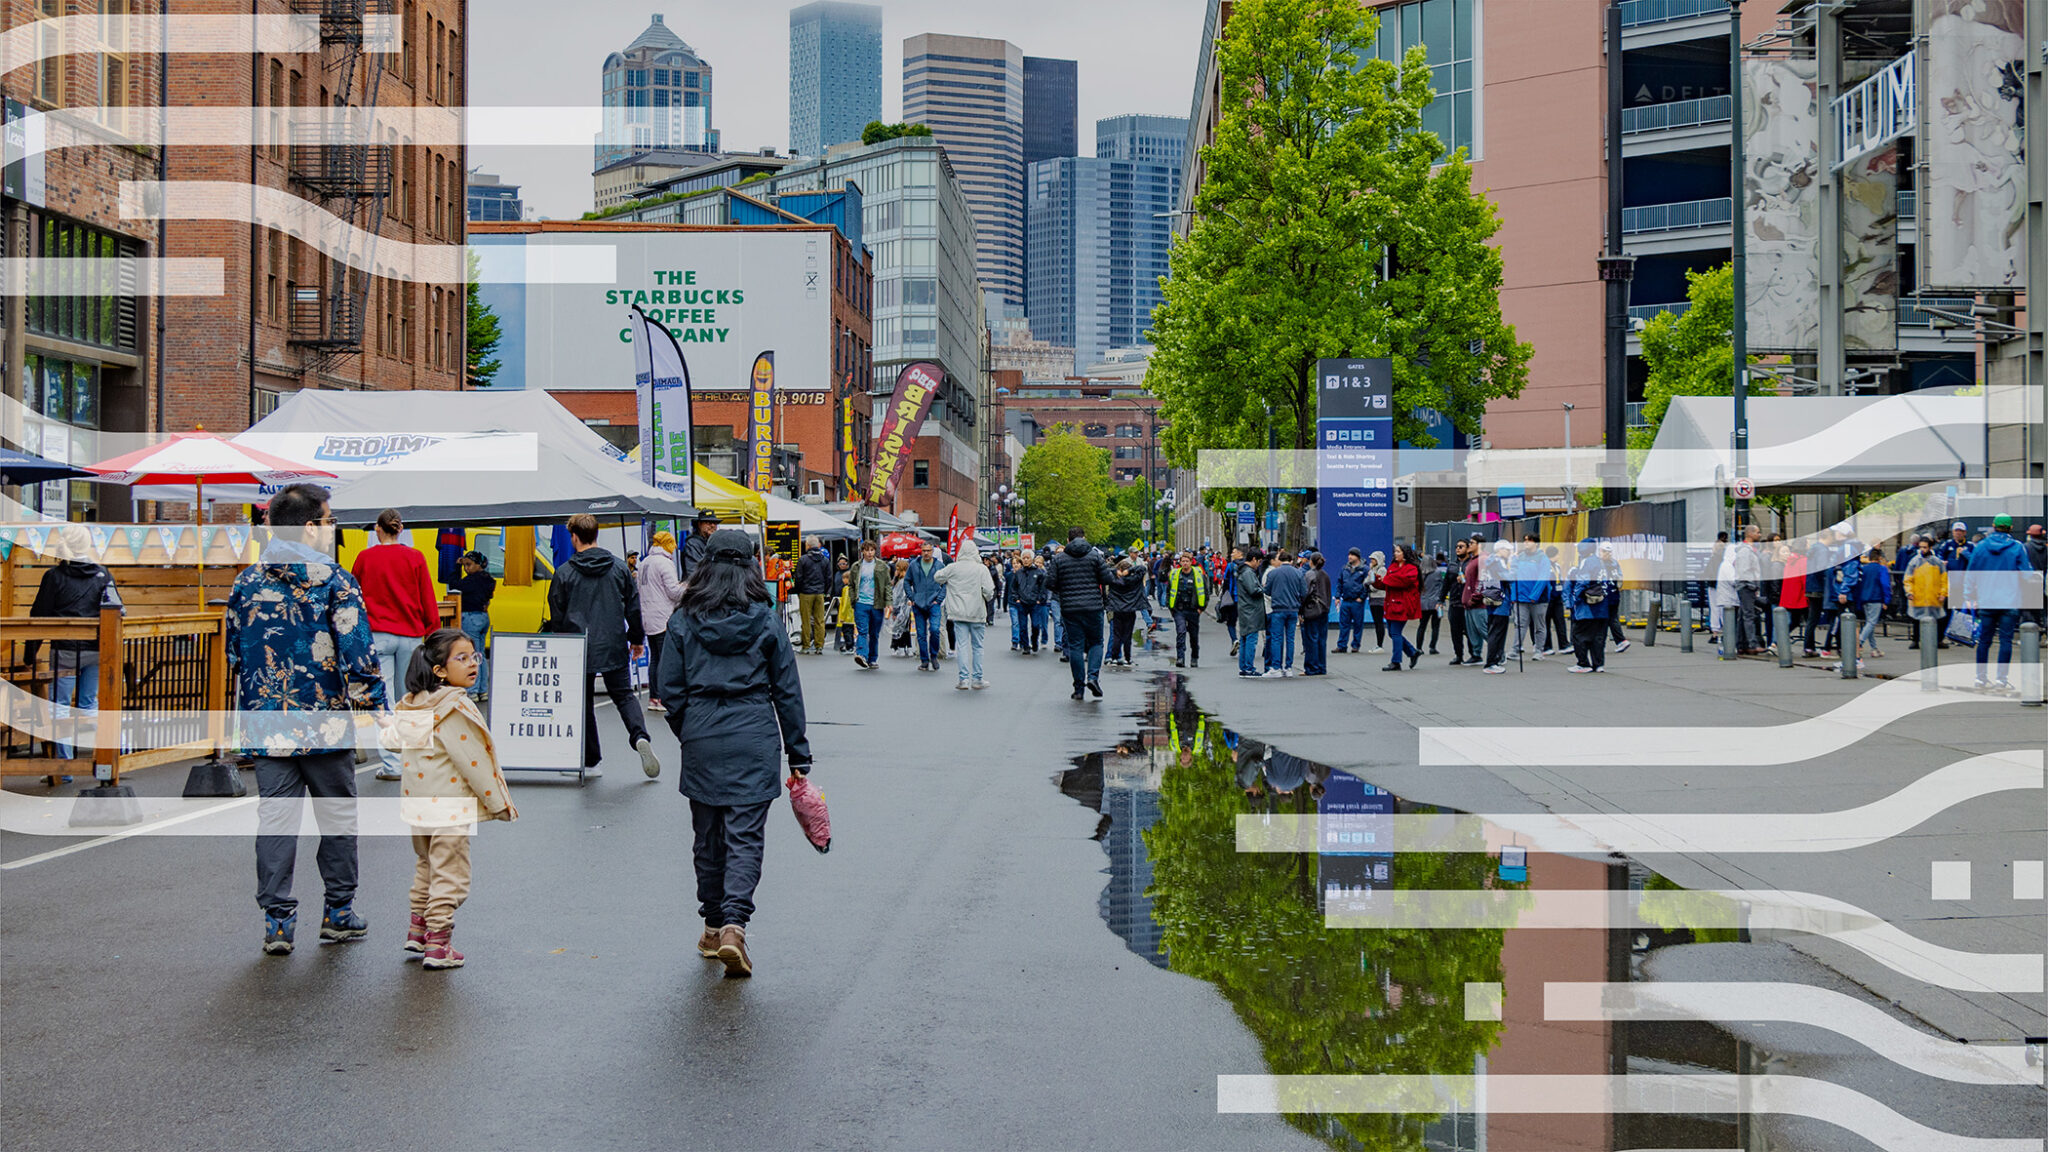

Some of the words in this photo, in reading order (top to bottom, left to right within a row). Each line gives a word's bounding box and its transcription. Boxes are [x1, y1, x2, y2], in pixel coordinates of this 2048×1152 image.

[7, 125, 24, 148] Lease
[653, 270, 696, 285] THE
[606, 289, 744, 305] STARBUCKS
[643, 308, 715, 323] OFFEE
[619, 328, 730, 343] CPANY
[1342, 377, 1348, 388] 1
[1352, 377, 1361, 388] &
[1364, 377, 1371, 388] 3
[791, 392, 825, 404] 901B
[1363, 397, 1370, 408] 7
[324, 438, 383, 456] PRO
[386, 435, 441, 453] IM
[753, 391, 772, 490] BURGER
[1166, 490, 1174, 499] 4
[1397, 487, 1408, 502] 5
[522, 656, 557, 669] OPEN
[518, 673, 560, 686] TACOS
[509, 723, 574, 737] TEQUILA
